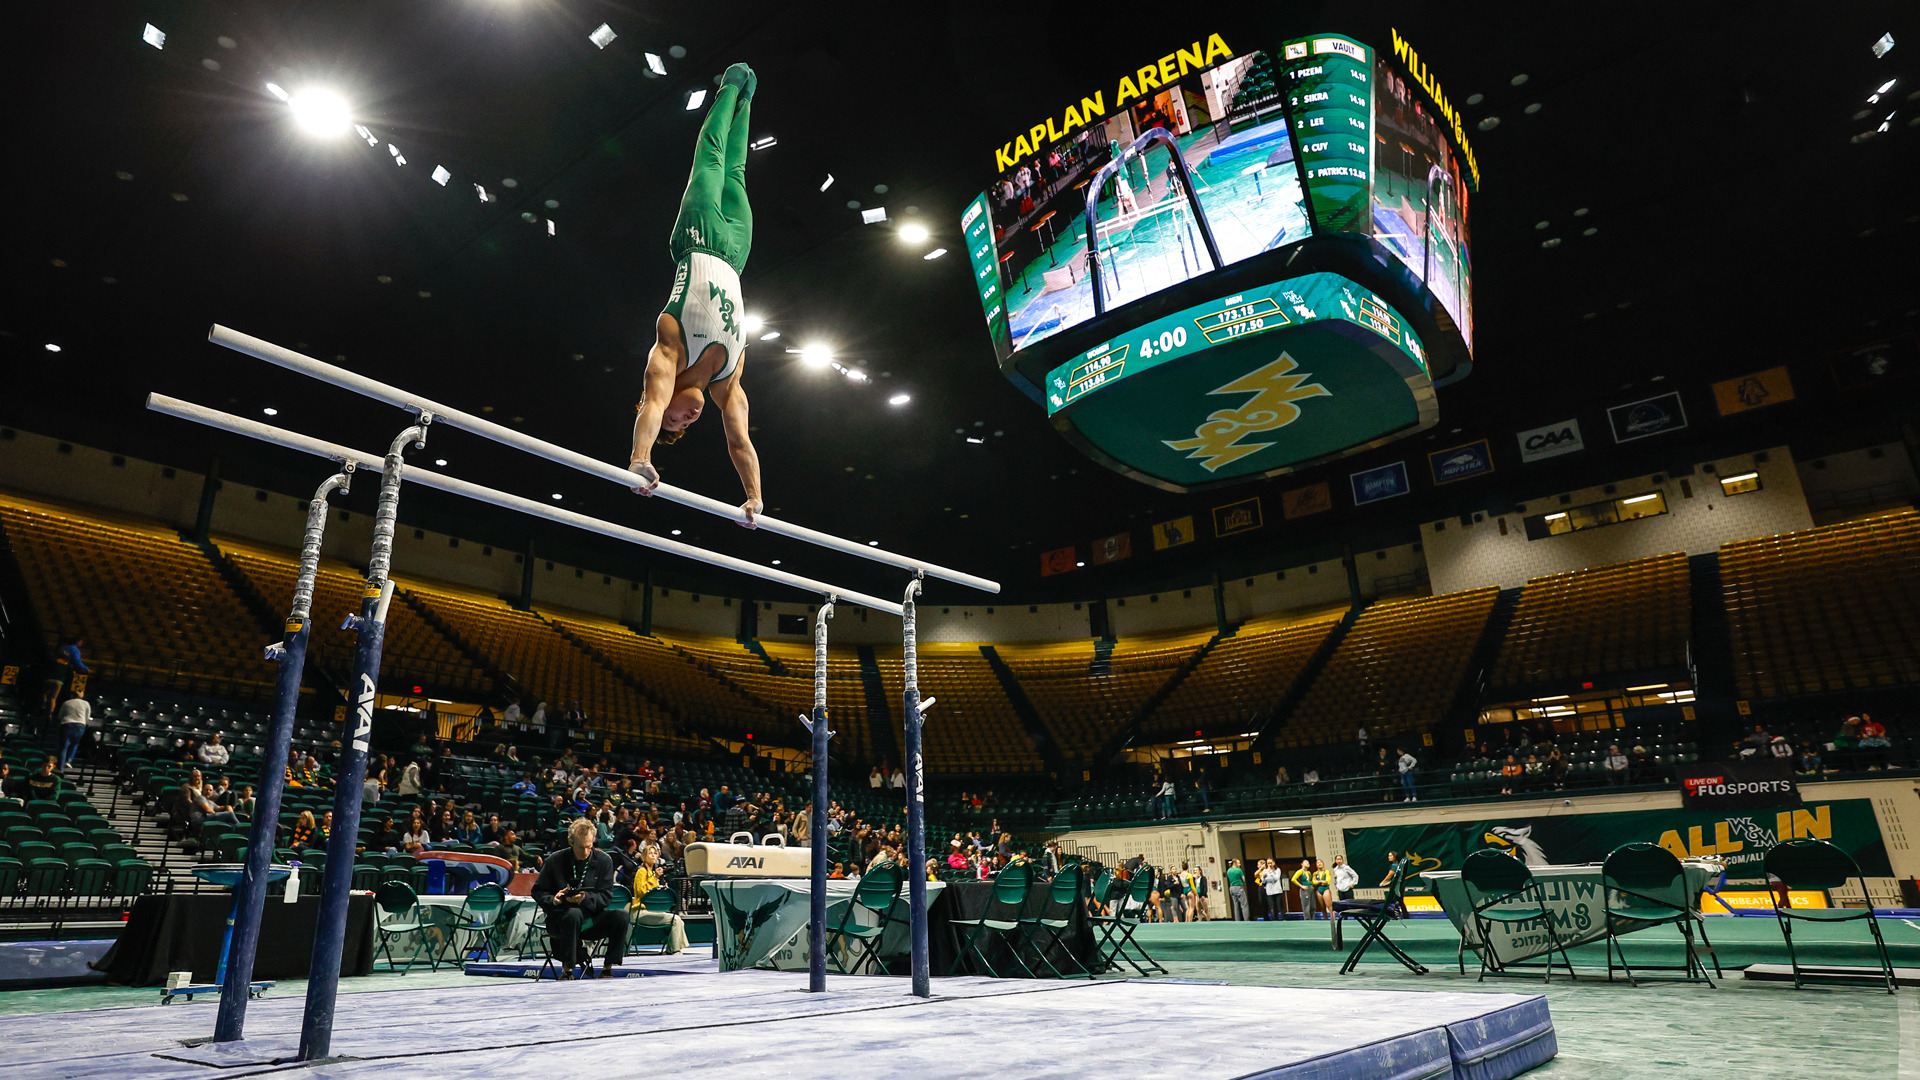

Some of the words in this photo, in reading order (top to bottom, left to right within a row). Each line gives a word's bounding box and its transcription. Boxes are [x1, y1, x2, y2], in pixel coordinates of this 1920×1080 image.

[1332, 41, 1355, 55] VAULT
[1289, 71, 1295, 80] 1
[1297, 66, 1323, 79] PIZEM
[1391, 27, 1454, 128] WILLIAM
[995, 90, 1106, 173] KAPLAN
[1116, 32, 1234, 107] ARENA
[1291, 97, 1298, 106] 2
[1303, 92, 1329, 104] SIKRA
[1297, 120, 1304, 129] 2
[1310, 117, 1324, 127] LEE
[1302, 144, 1309, 153] 4
[1311, 142, 1329, 152] CUY
[1307, 170, 1314, 179] 5
[1317, 166, 1348, 177] PATRICK
[670, 262, 688, 303] TRIBE
[1225, 295, 1243, 306] MEN
[1217, 305, 1255, 323] 173.15
[1226, 318, 1264, 336] 177.50
[1086, 343, 1110, 359] WOMEN
[1139, 326, 1188, 359] 4:00
[1084, 355, 1112, 374] 114.90
[1079, 373, 1106, 392] 113.65
[1525, 427, 1575, 450] CAA
[1698, 780, 1791, 796] FLOSPORTS
[1706, 777, 1718, 785] ON
[1776, 805, 1832, 842] IN
[1657, 821, 1744, 858] ALL
